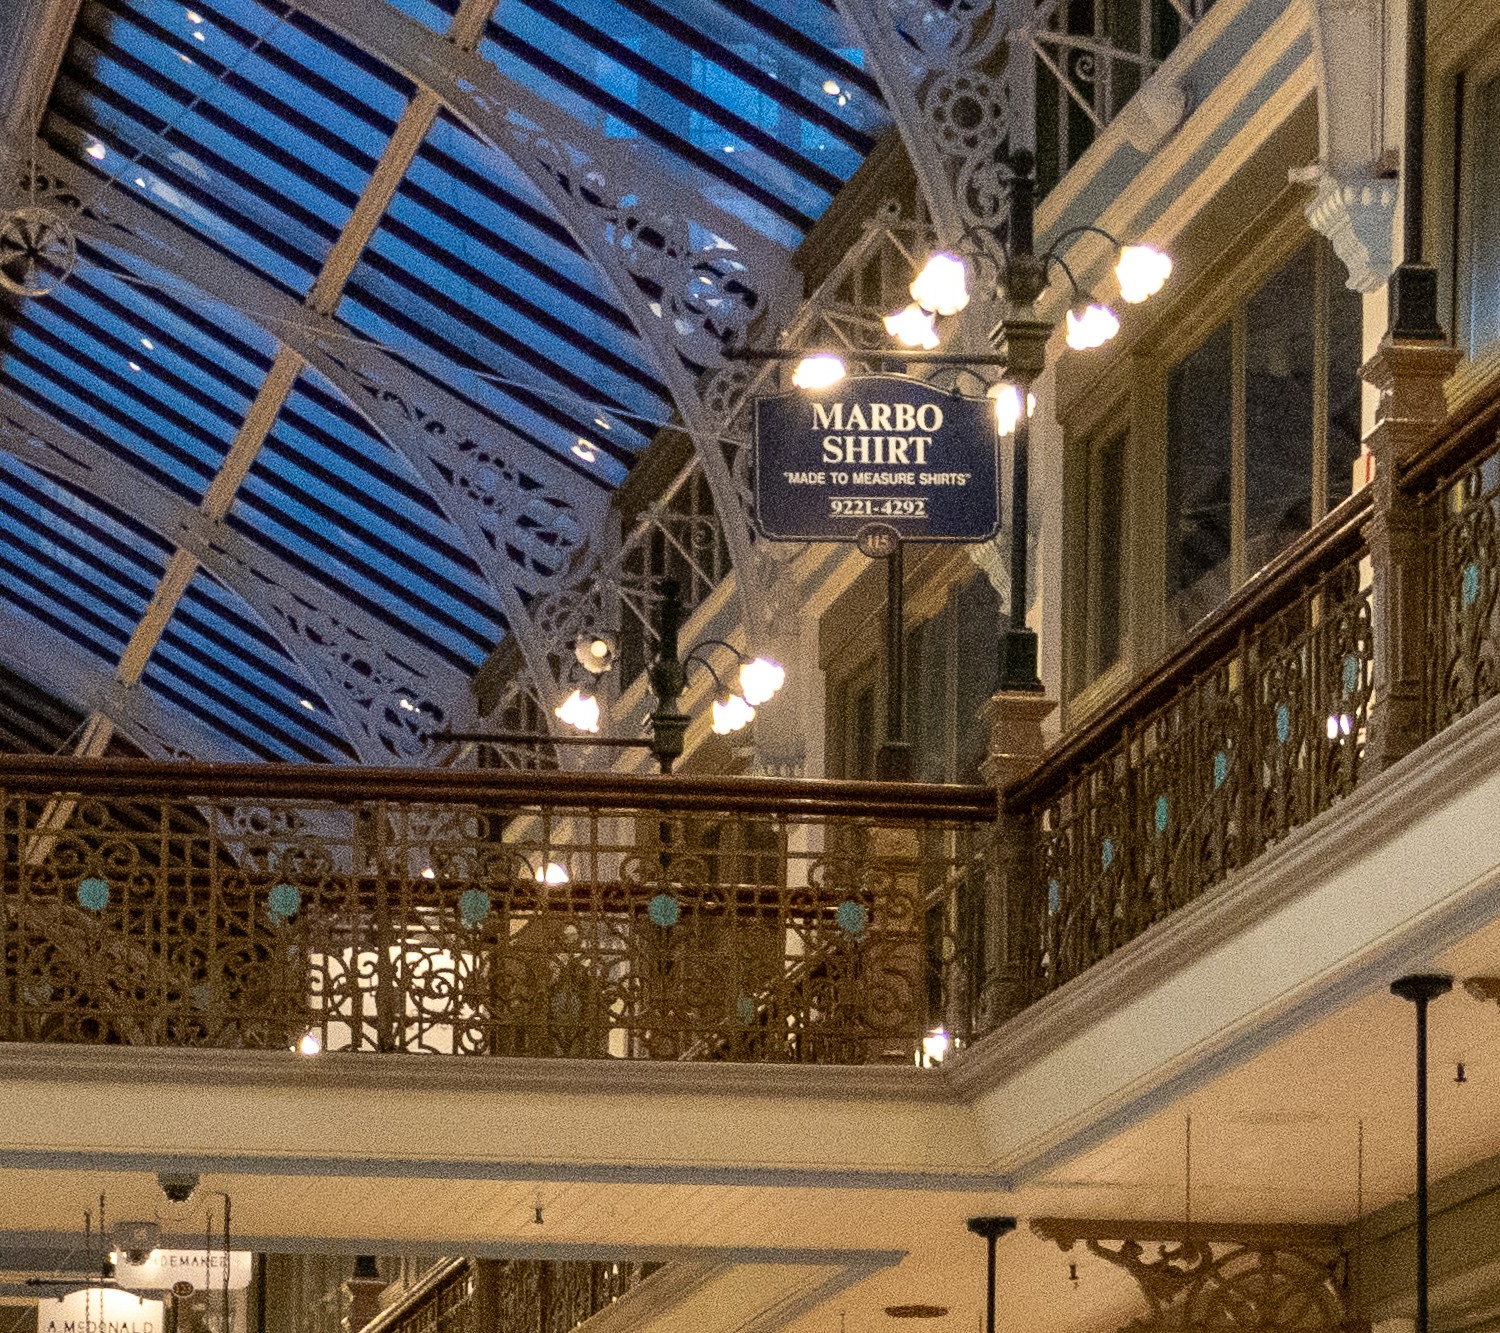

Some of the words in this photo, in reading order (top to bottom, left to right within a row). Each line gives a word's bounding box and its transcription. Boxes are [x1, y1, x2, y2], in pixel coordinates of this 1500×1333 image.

[811, 402, 943, 431] MARBO
[822, 435, 932, 465] SHIRT
[830, 473, 848, 486] TO
[852, 472, 915, 486] MEASURE
[830, 499, 925, 516] 9221-4292
